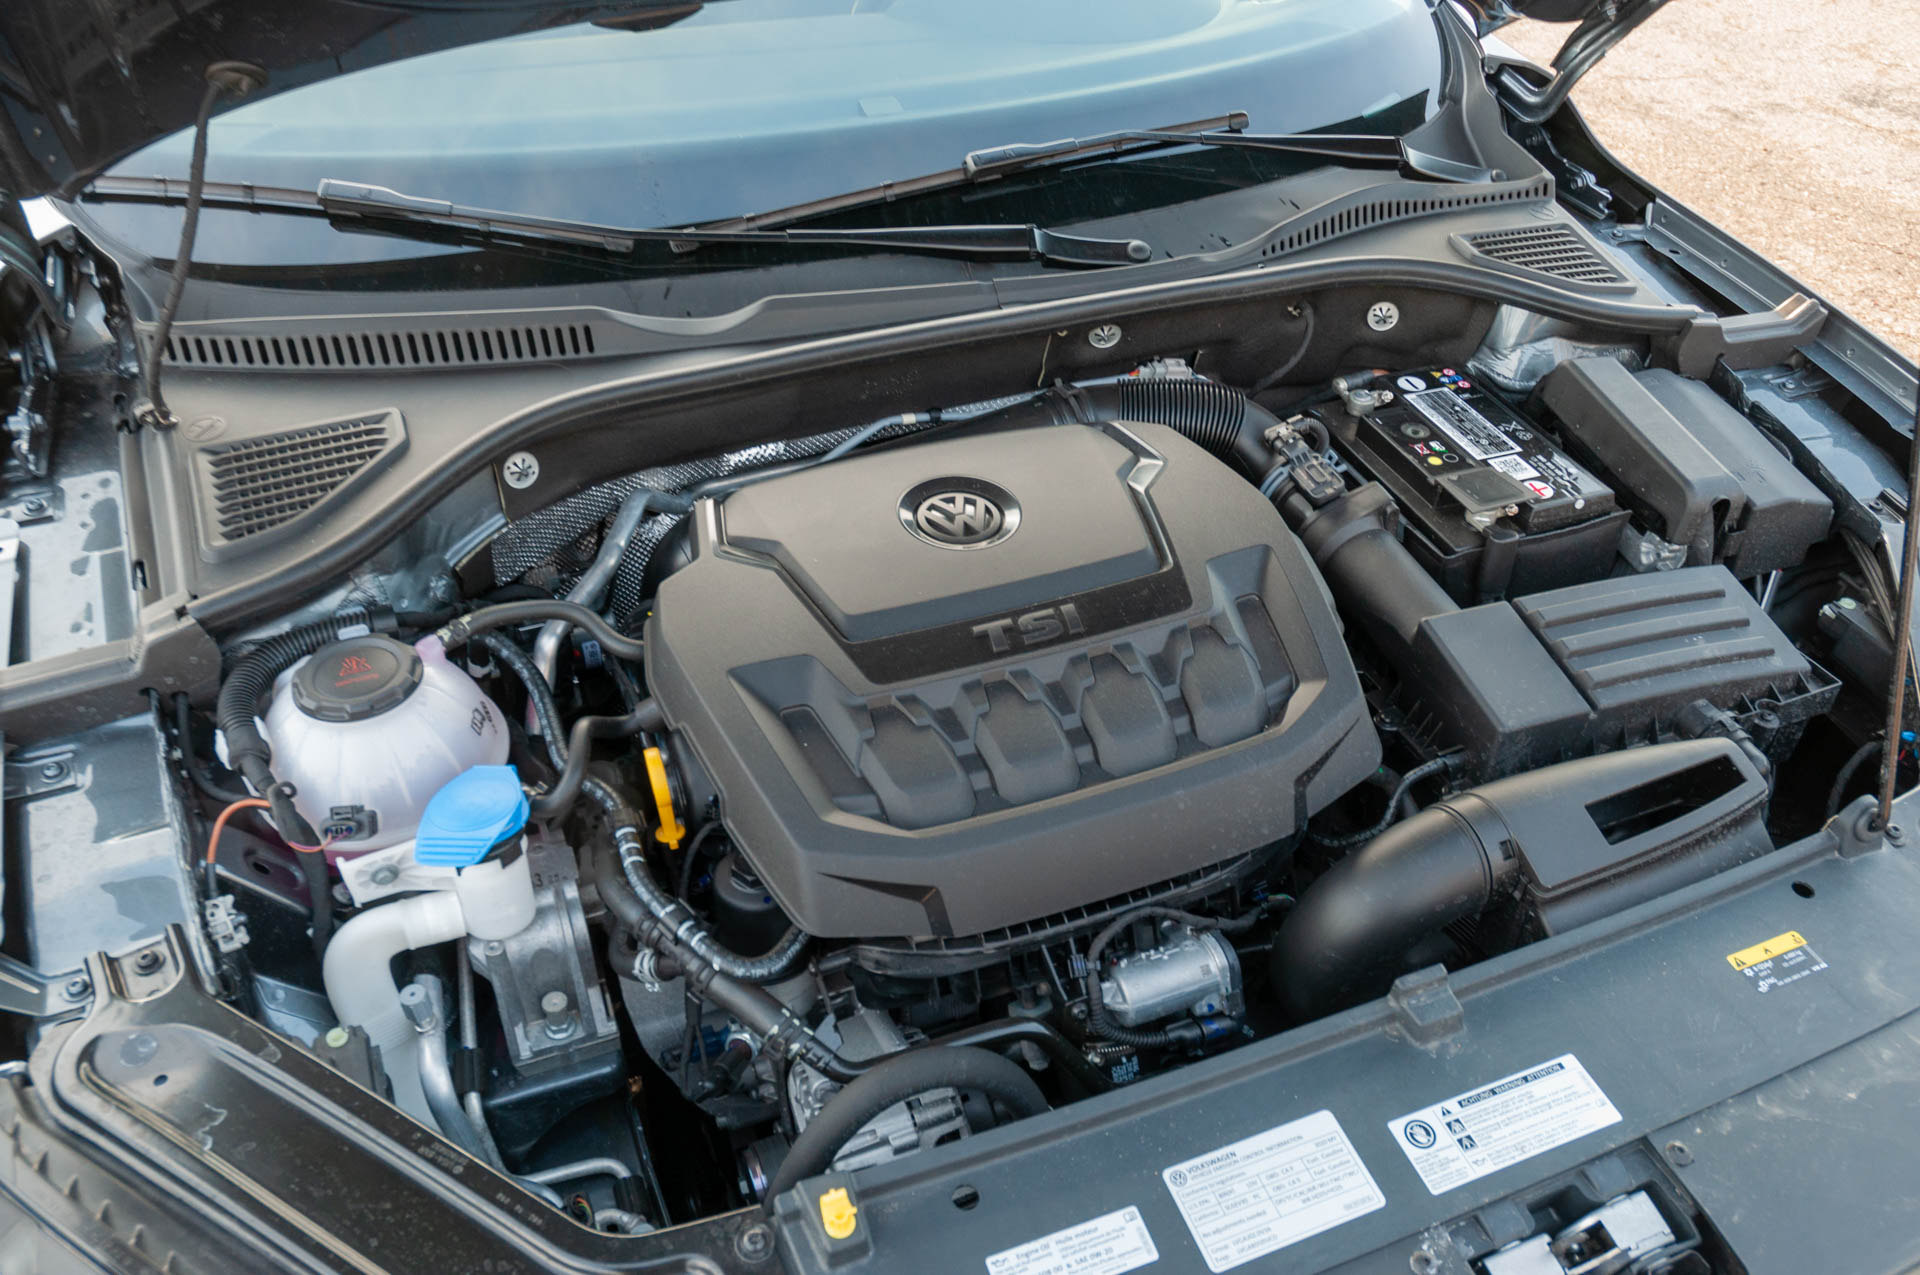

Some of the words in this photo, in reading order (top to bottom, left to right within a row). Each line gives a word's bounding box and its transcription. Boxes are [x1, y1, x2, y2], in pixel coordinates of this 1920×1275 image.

[971, 603, 1087, 653] TSI
[1461, 1088, 1494, 1107] ACHTUNG
[1494, 1077, 1526, 1095] WARNING
[1527, 1064, 1561, 1083] ATTENTION
[1186, 1151, 1237, 1175] VOLKSWAGEN
